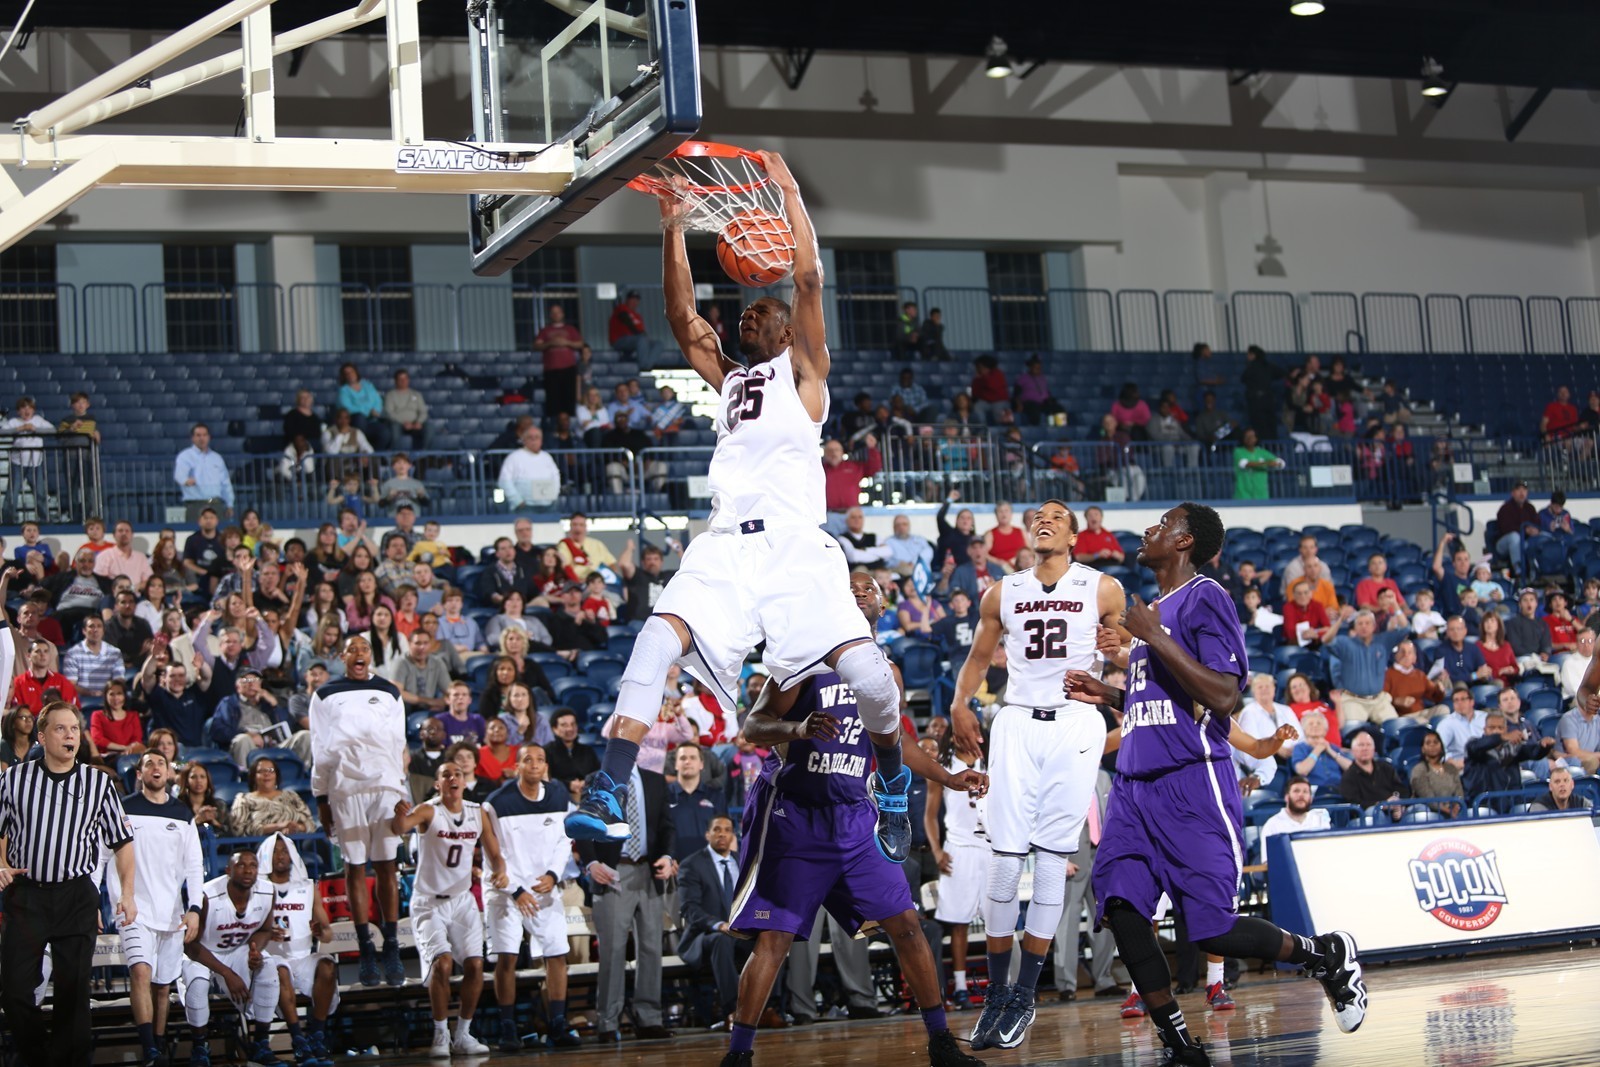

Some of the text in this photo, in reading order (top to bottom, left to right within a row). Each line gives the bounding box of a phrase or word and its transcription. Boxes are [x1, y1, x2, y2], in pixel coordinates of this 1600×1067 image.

[727, 377, 767, 431] 25
[1014, 600, 1084, 614] SAMFORD
[1023, 618, 1068, 660] 32
[820, 683, 857, 709] WES
[839, 716, 866, 746] 32
[1426, 841, 1475, 859] SOUTHERN
[1408, 849, 1508, 912] SOCON
[1438, 905, 1498, 928] CONFERENCE
[216, 931, 250, 949] 33
